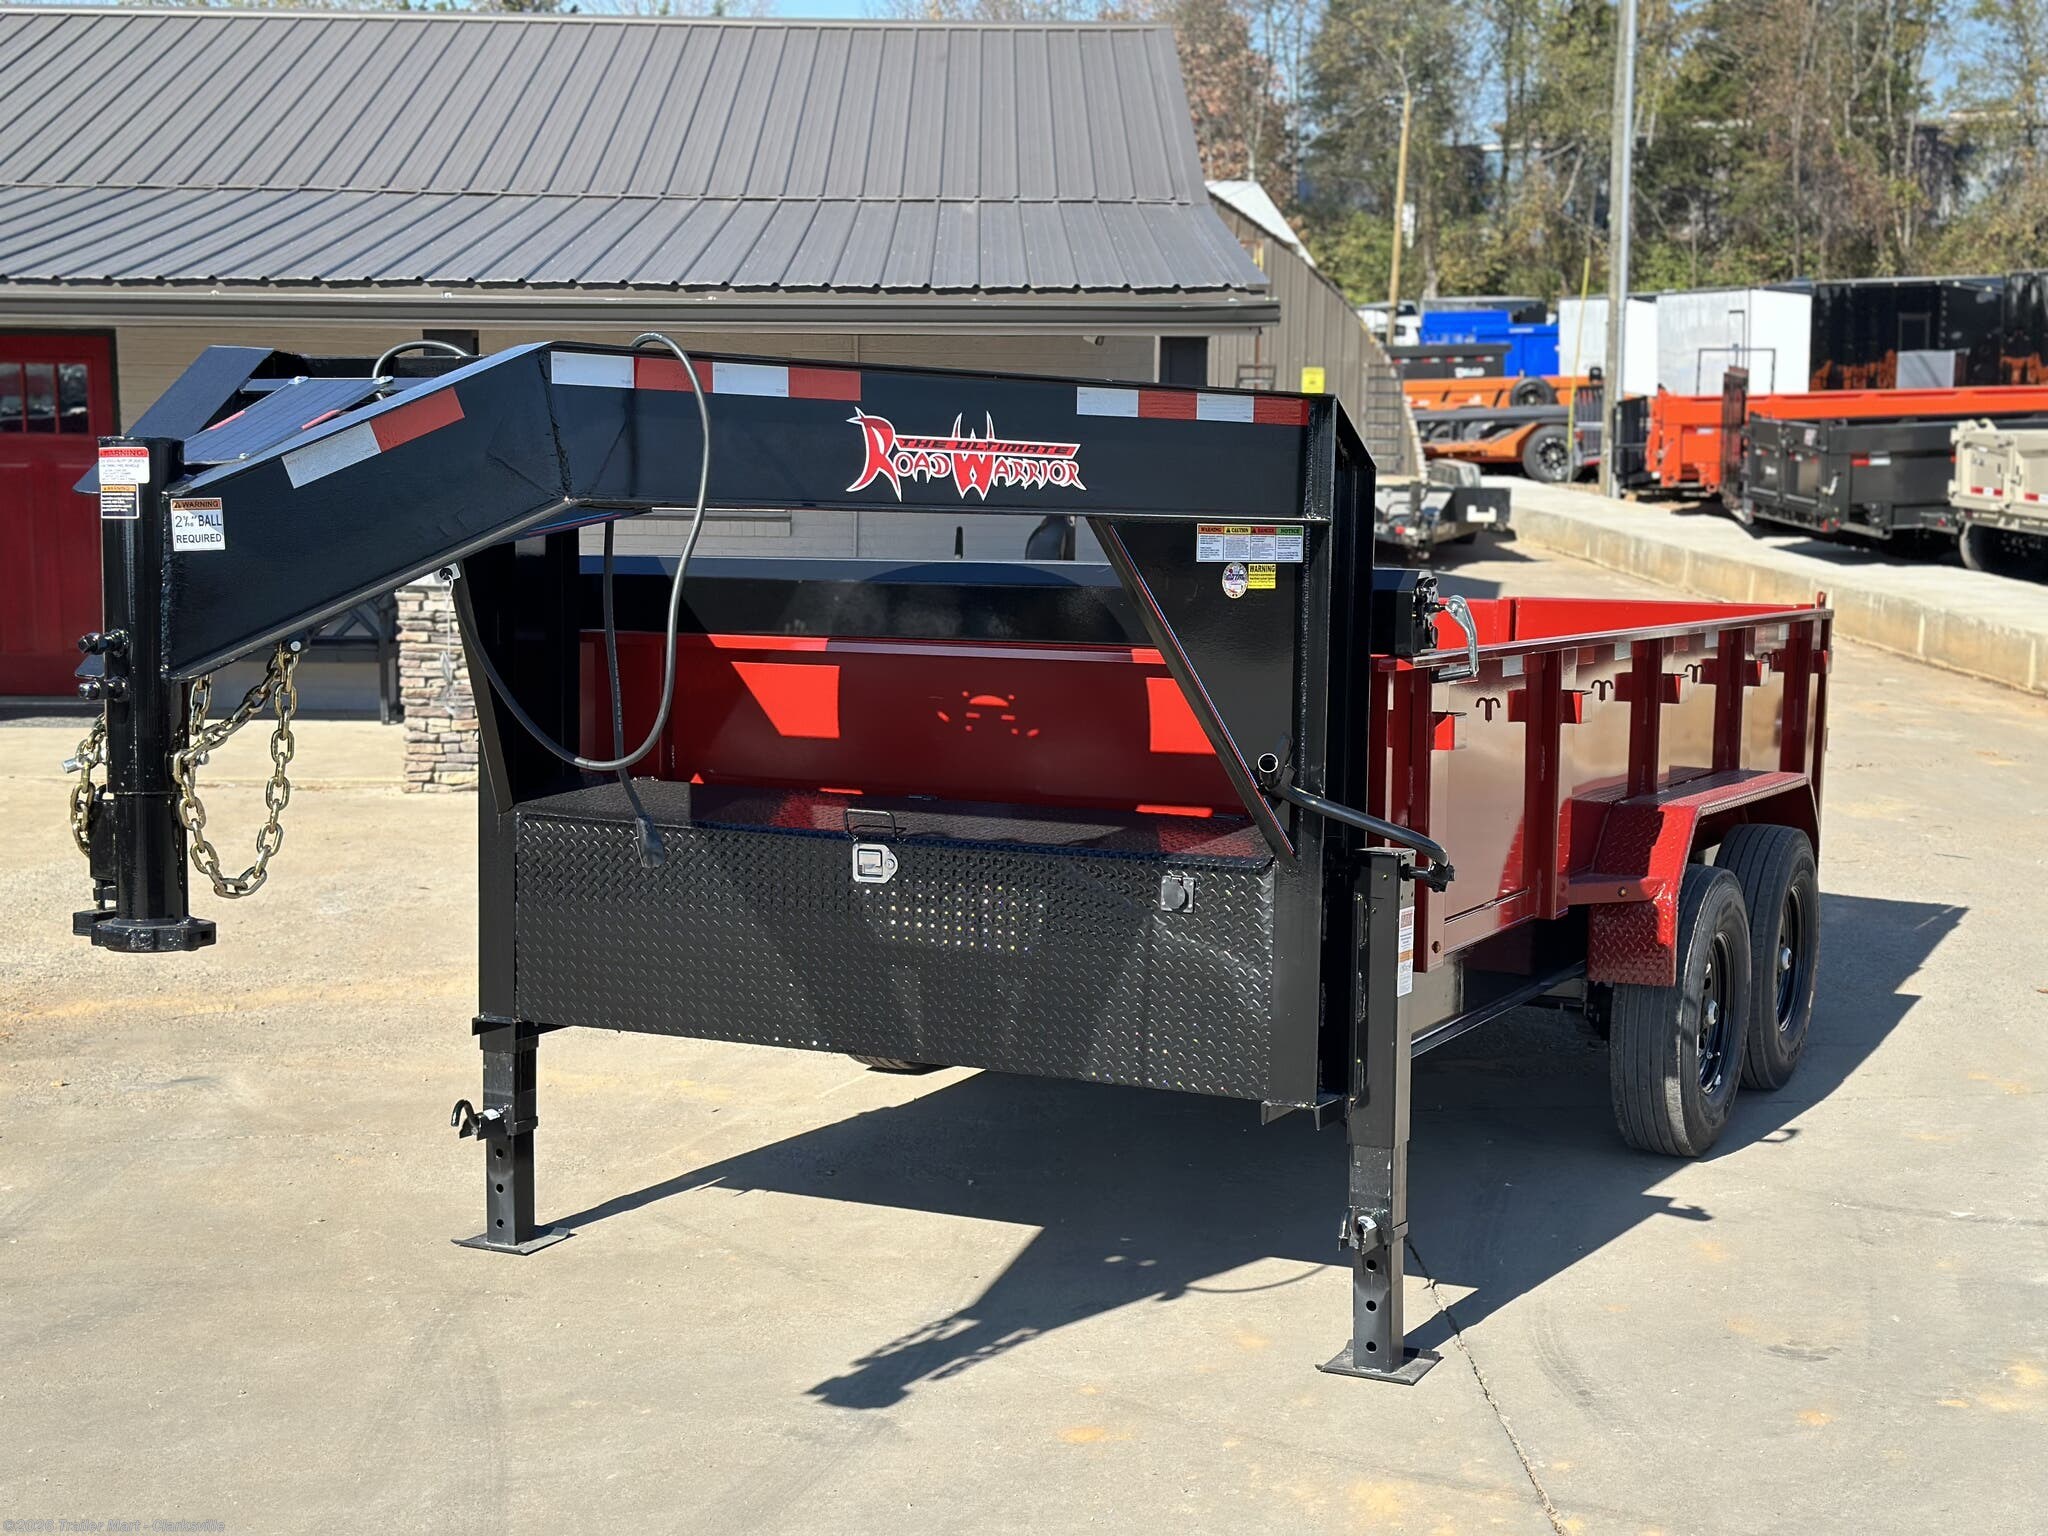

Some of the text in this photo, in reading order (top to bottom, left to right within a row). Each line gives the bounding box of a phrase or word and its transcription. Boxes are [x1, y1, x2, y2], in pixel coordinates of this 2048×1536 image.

[900, 438, 1074, 456] THE ULTIMATE
[198, 514, 222, 527] BALL
[176, 533, 222, 543] REQUIRED
[1249, 565, 1275, 573] WARNING
